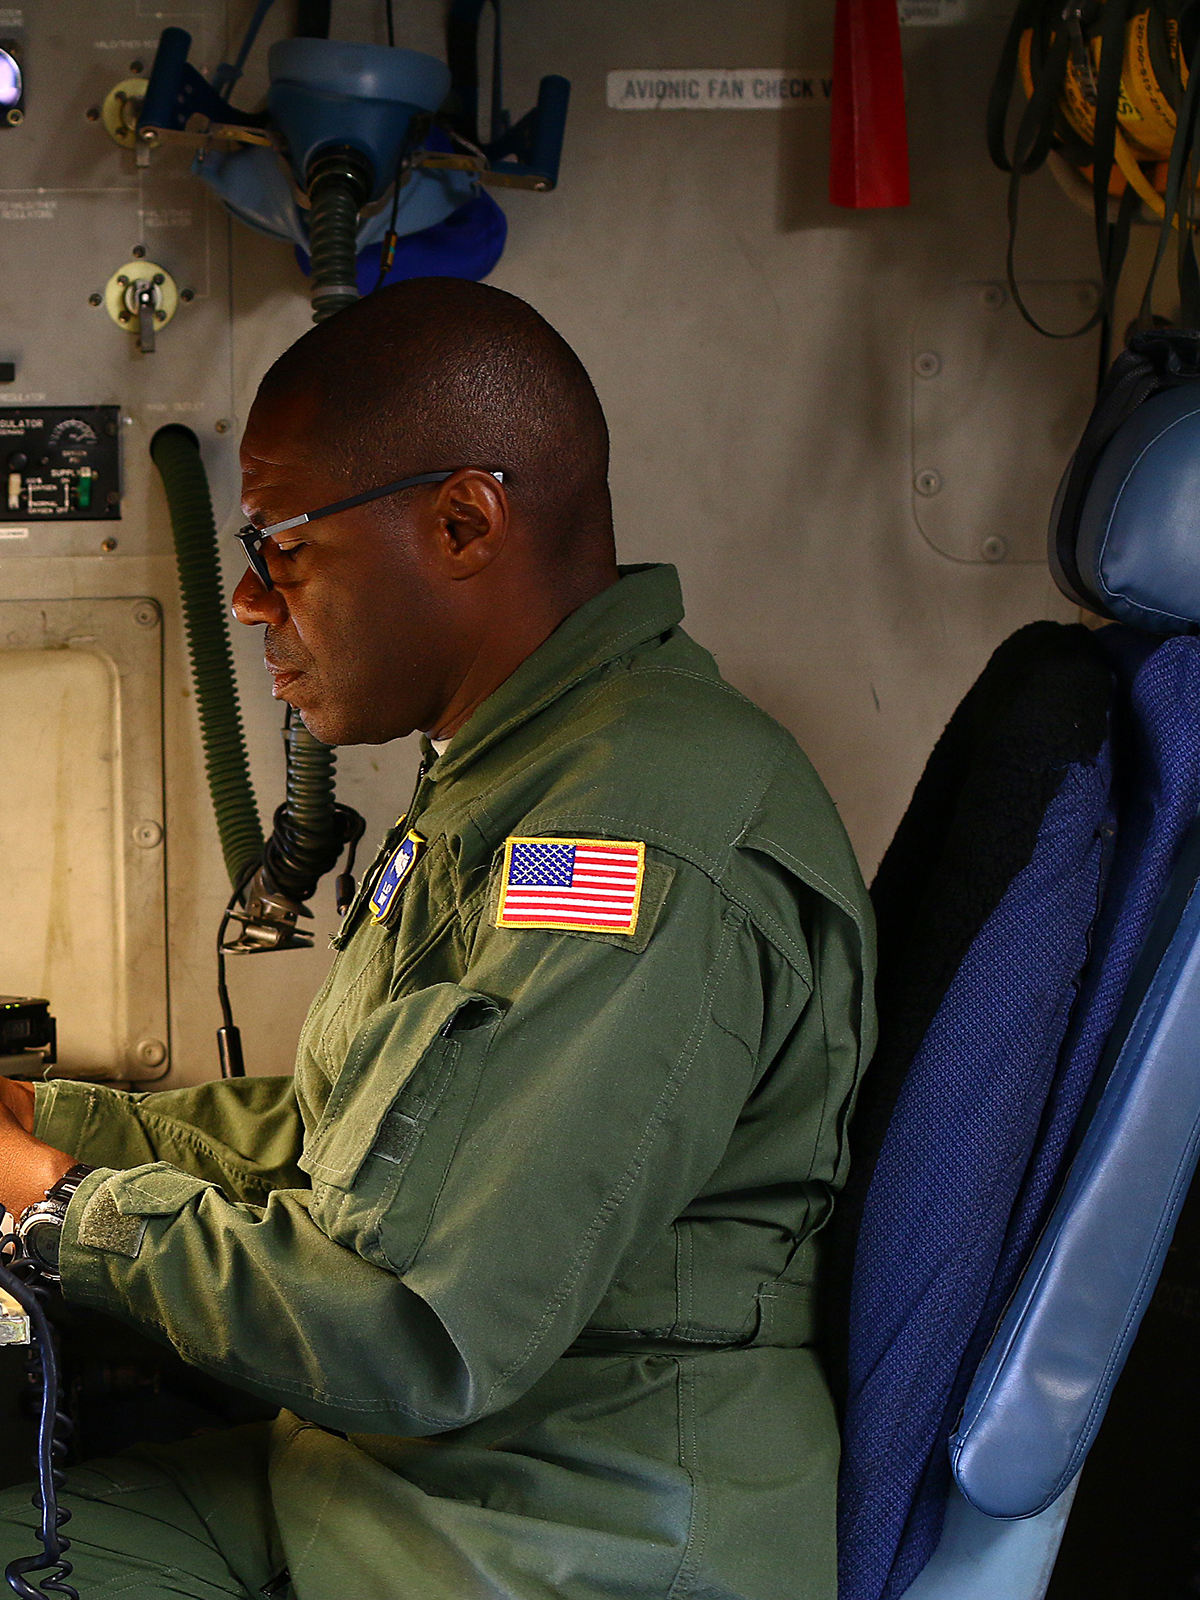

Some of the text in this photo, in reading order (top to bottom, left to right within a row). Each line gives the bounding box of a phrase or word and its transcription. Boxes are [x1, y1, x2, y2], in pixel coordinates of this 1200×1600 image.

[624, 79, 700, 99] AVIONIC
[708, 79, 744, 98] FAN
[753, 78, 814, 98] CHECK
